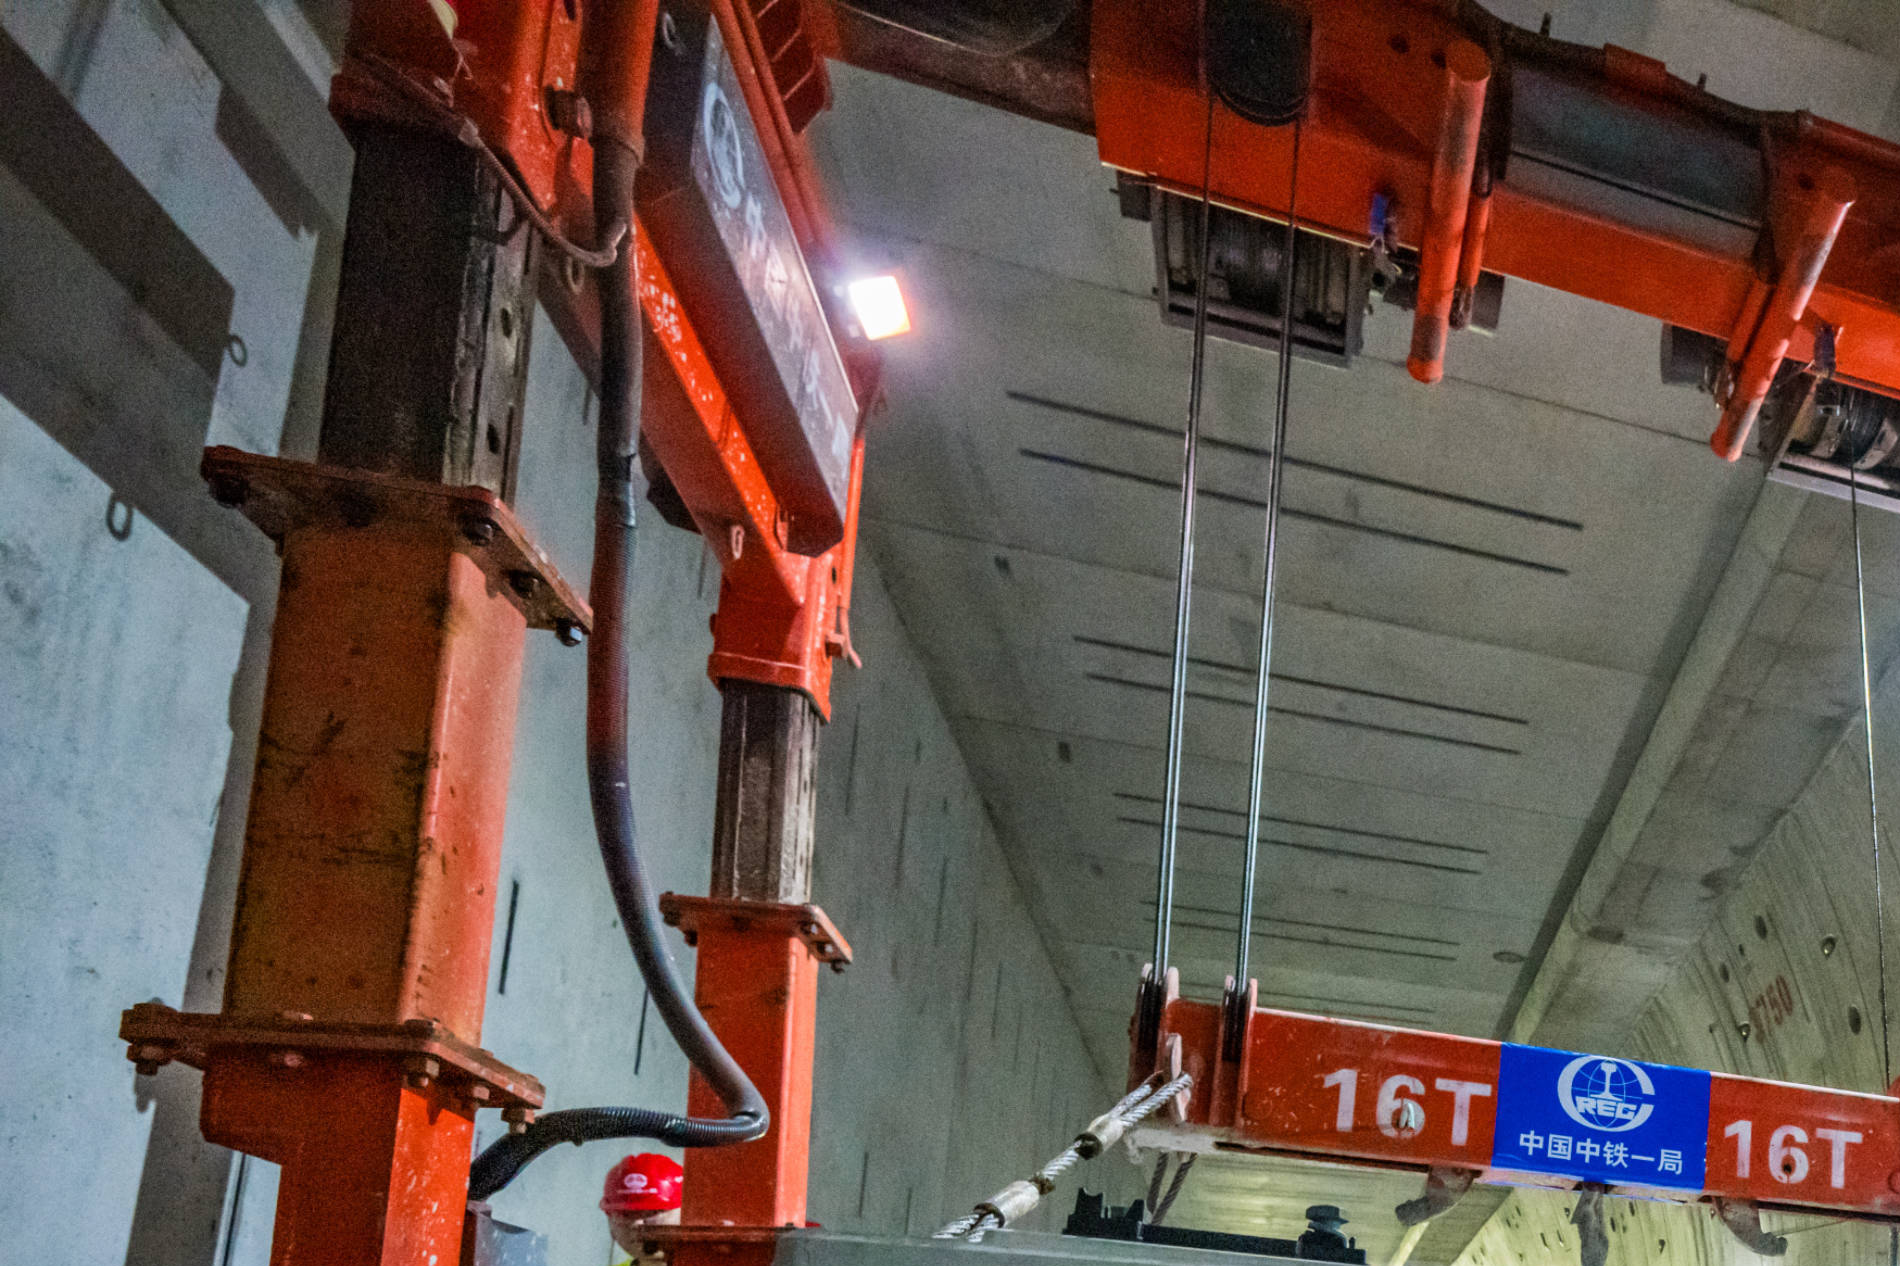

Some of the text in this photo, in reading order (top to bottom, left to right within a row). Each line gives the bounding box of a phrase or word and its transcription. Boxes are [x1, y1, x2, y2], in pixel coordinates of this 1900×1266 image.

[1323, 1067, 1492, 1147] 16T
[1519, 1129, 1683, 1175] 中国中铁一局
[1724, 1119, 1863, 1190] 16T
